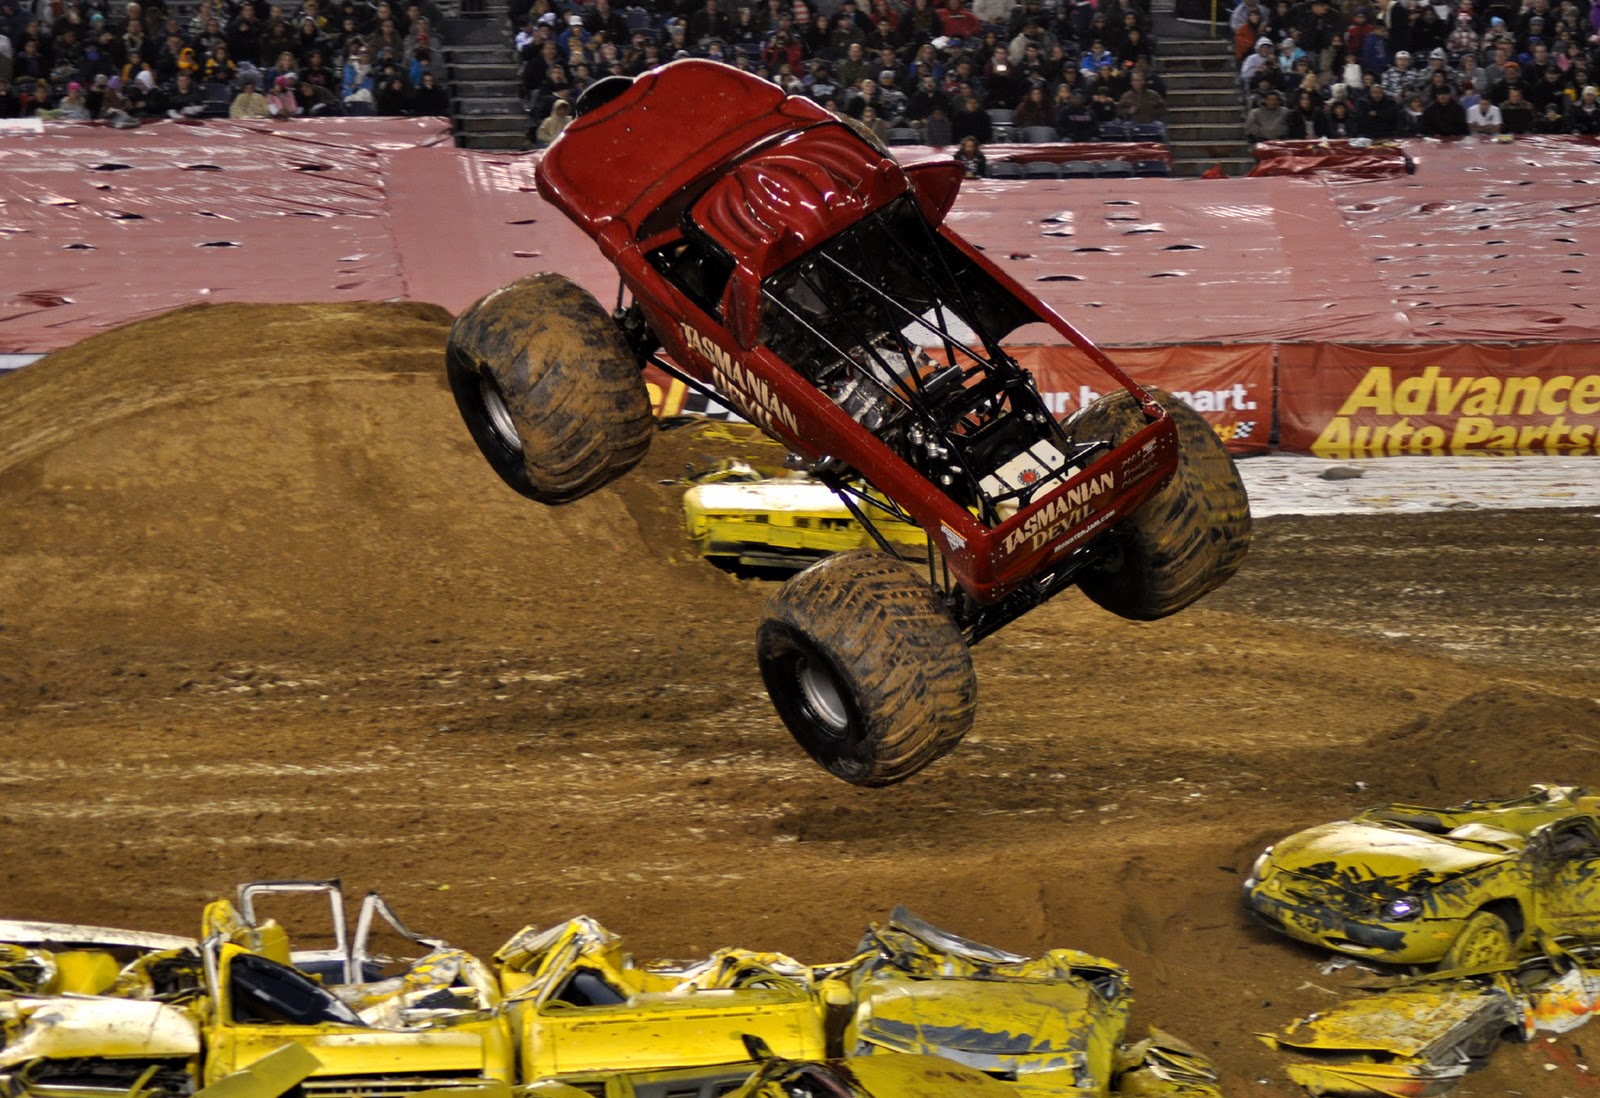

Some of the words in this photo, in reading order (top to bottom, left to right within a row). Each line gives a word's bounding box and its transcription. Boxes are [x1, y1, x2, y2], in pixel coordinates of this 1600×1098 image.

[680, 322, 799, 436] TASMANIAN
[712, 366, 783, 438] DEVIL
[1337, 366, 1600, 415] Advance
[1310, 417, 1446, 458] Auto
[1451, 417, 1594, 457] Parts
[1001, 471, 1115, 554] TASMANIAN
[1032, 504, 1096, 551] DEVIL
